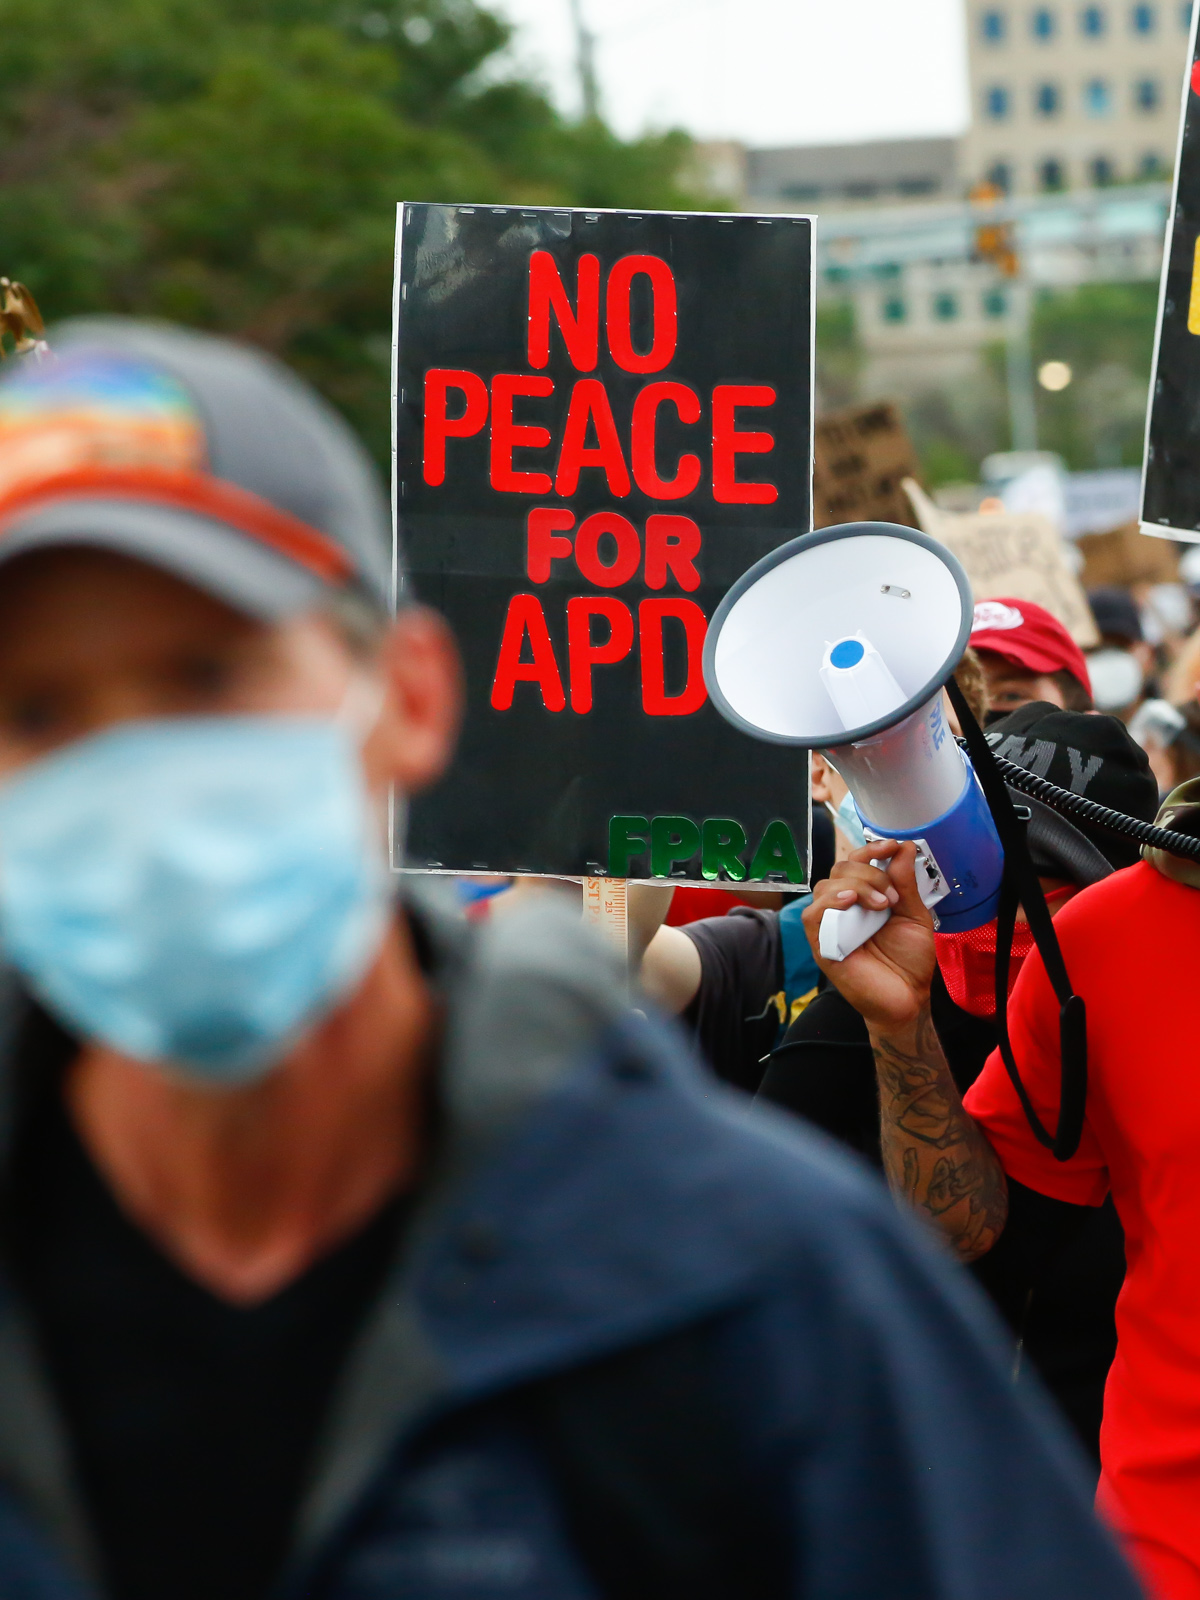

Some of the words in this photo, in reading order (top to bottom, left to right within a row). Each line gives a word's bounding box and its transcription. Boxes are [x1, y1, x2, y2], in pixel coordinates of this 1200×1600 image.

[528, 251, 677, 374] NO
[423, 369, 778, 504] PEACE
[527, 508, 701, 592] FOR
[491, 594, 709, 716] APD
[608, 815, 804, 884] FPRA
